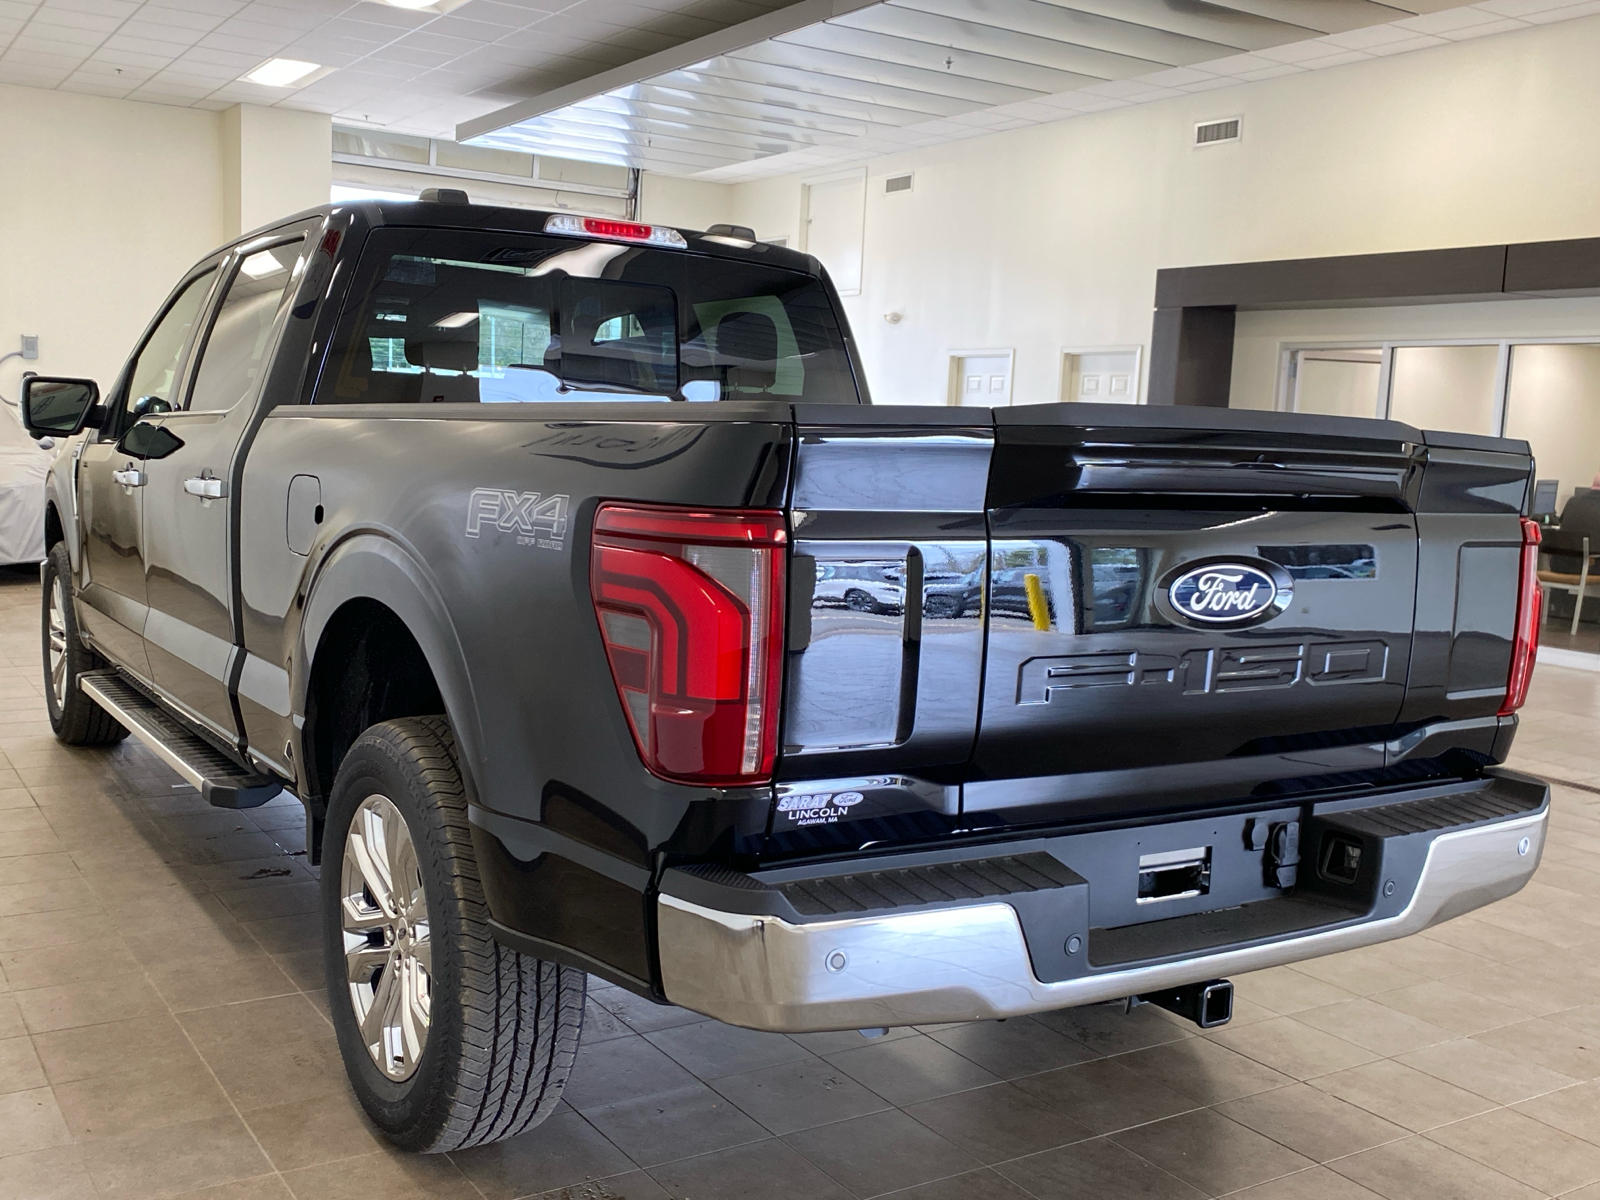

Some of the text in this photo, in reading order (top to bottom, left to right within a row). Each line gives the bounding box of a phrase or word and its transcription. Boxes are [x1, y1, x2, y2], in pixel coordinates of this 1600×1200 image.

[465, 487, 570, 540] FX4
[1190, 572, 1259, 611] Ford
[1015, 640, 1390, 706] F-150
[778, 794, 832, 810] SARAT
[788, 807, 848, 820] LINCOLN
[797, 818, 827, 826] AGAWAM,
